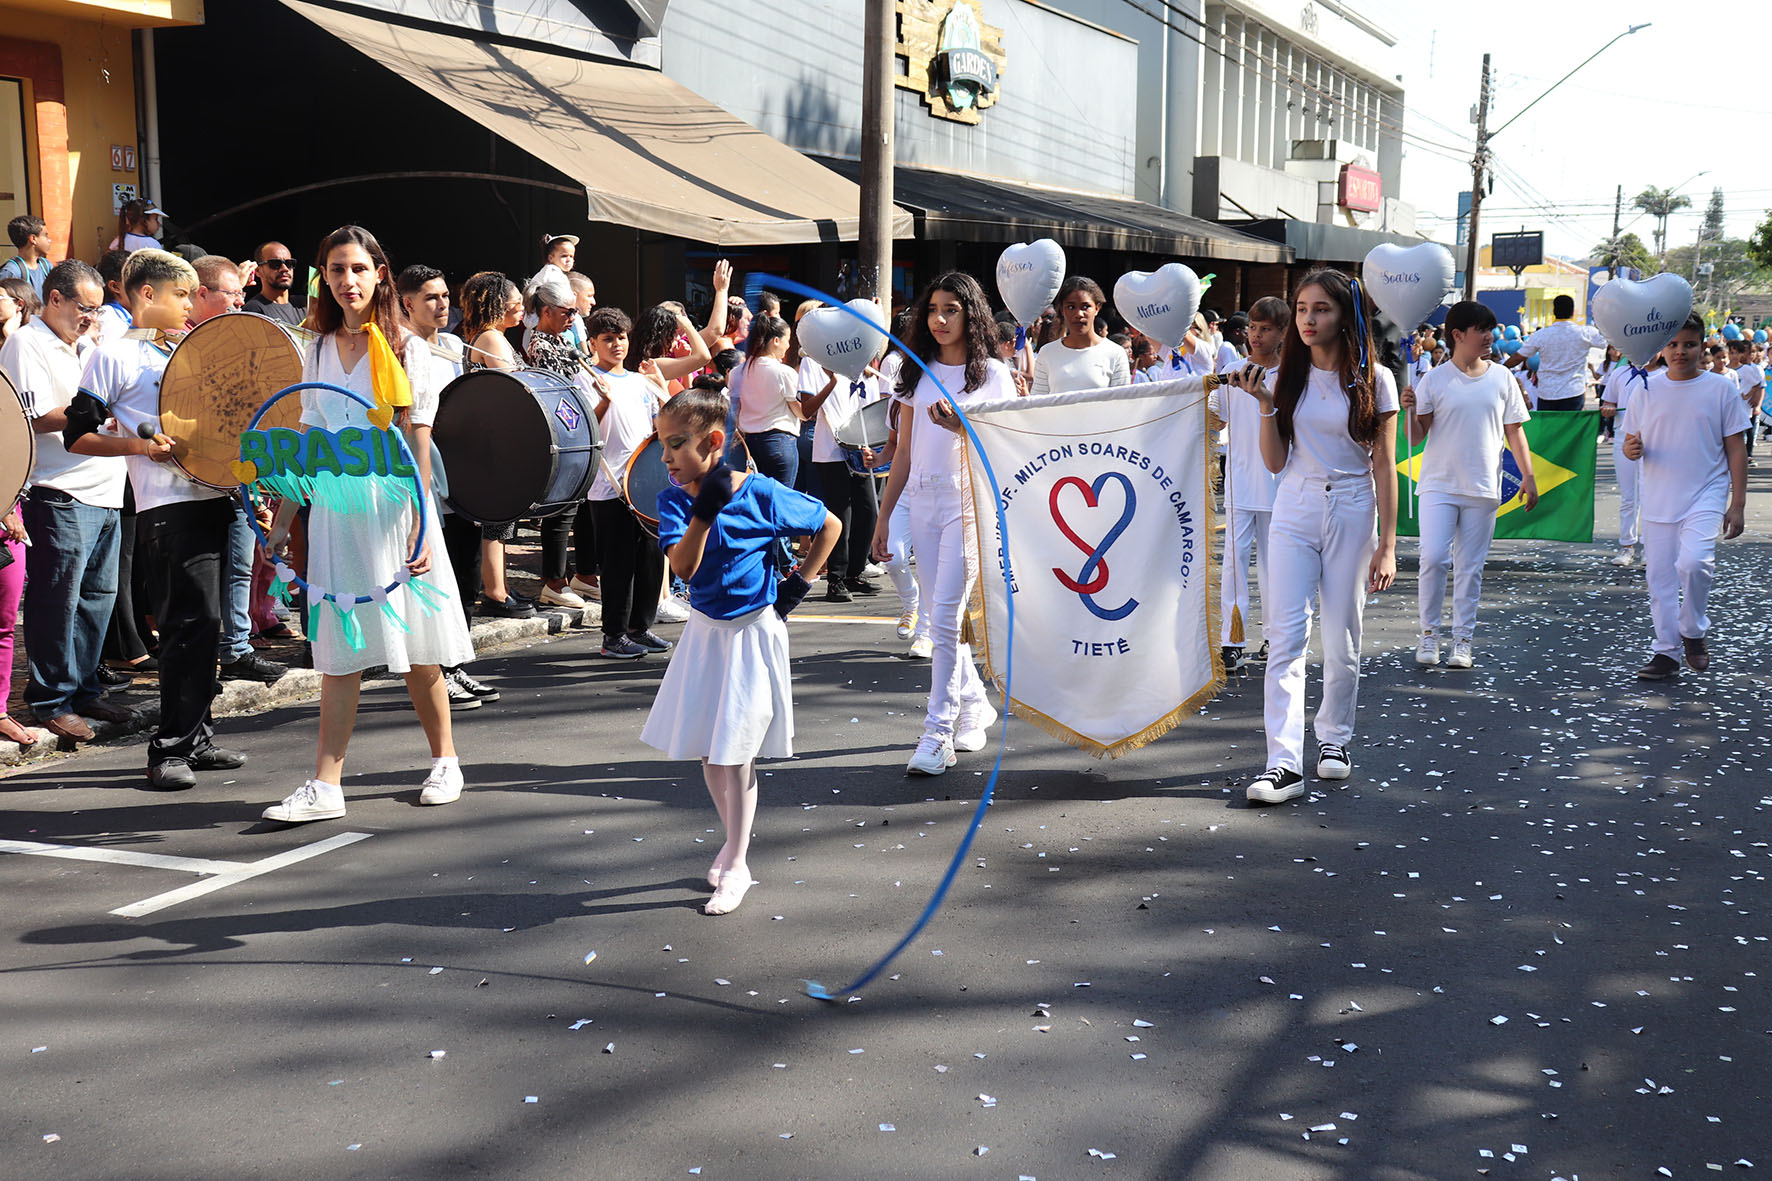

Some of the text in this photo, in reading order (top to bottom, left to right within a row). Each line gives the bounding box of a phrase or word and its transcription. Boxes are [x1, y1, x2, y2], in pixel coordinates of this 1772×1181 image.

[1382, 270, 1421, 285] Soares
[1136, 303, 1172, 320] Milton
[1646, 306, 1663, 323] de
[1623, 319, 1680, 337] Camargo
[825, 336, 863, 357] EMEB
[240, 428, 416, 478] BRASIL
[1014, 444, 1073, 485] MILTON
[1078, 442, 1151, 470] SOARES
[1151, 465, 1173, 491] DE
[1071, 637, 1131, 657] TIETÊ
